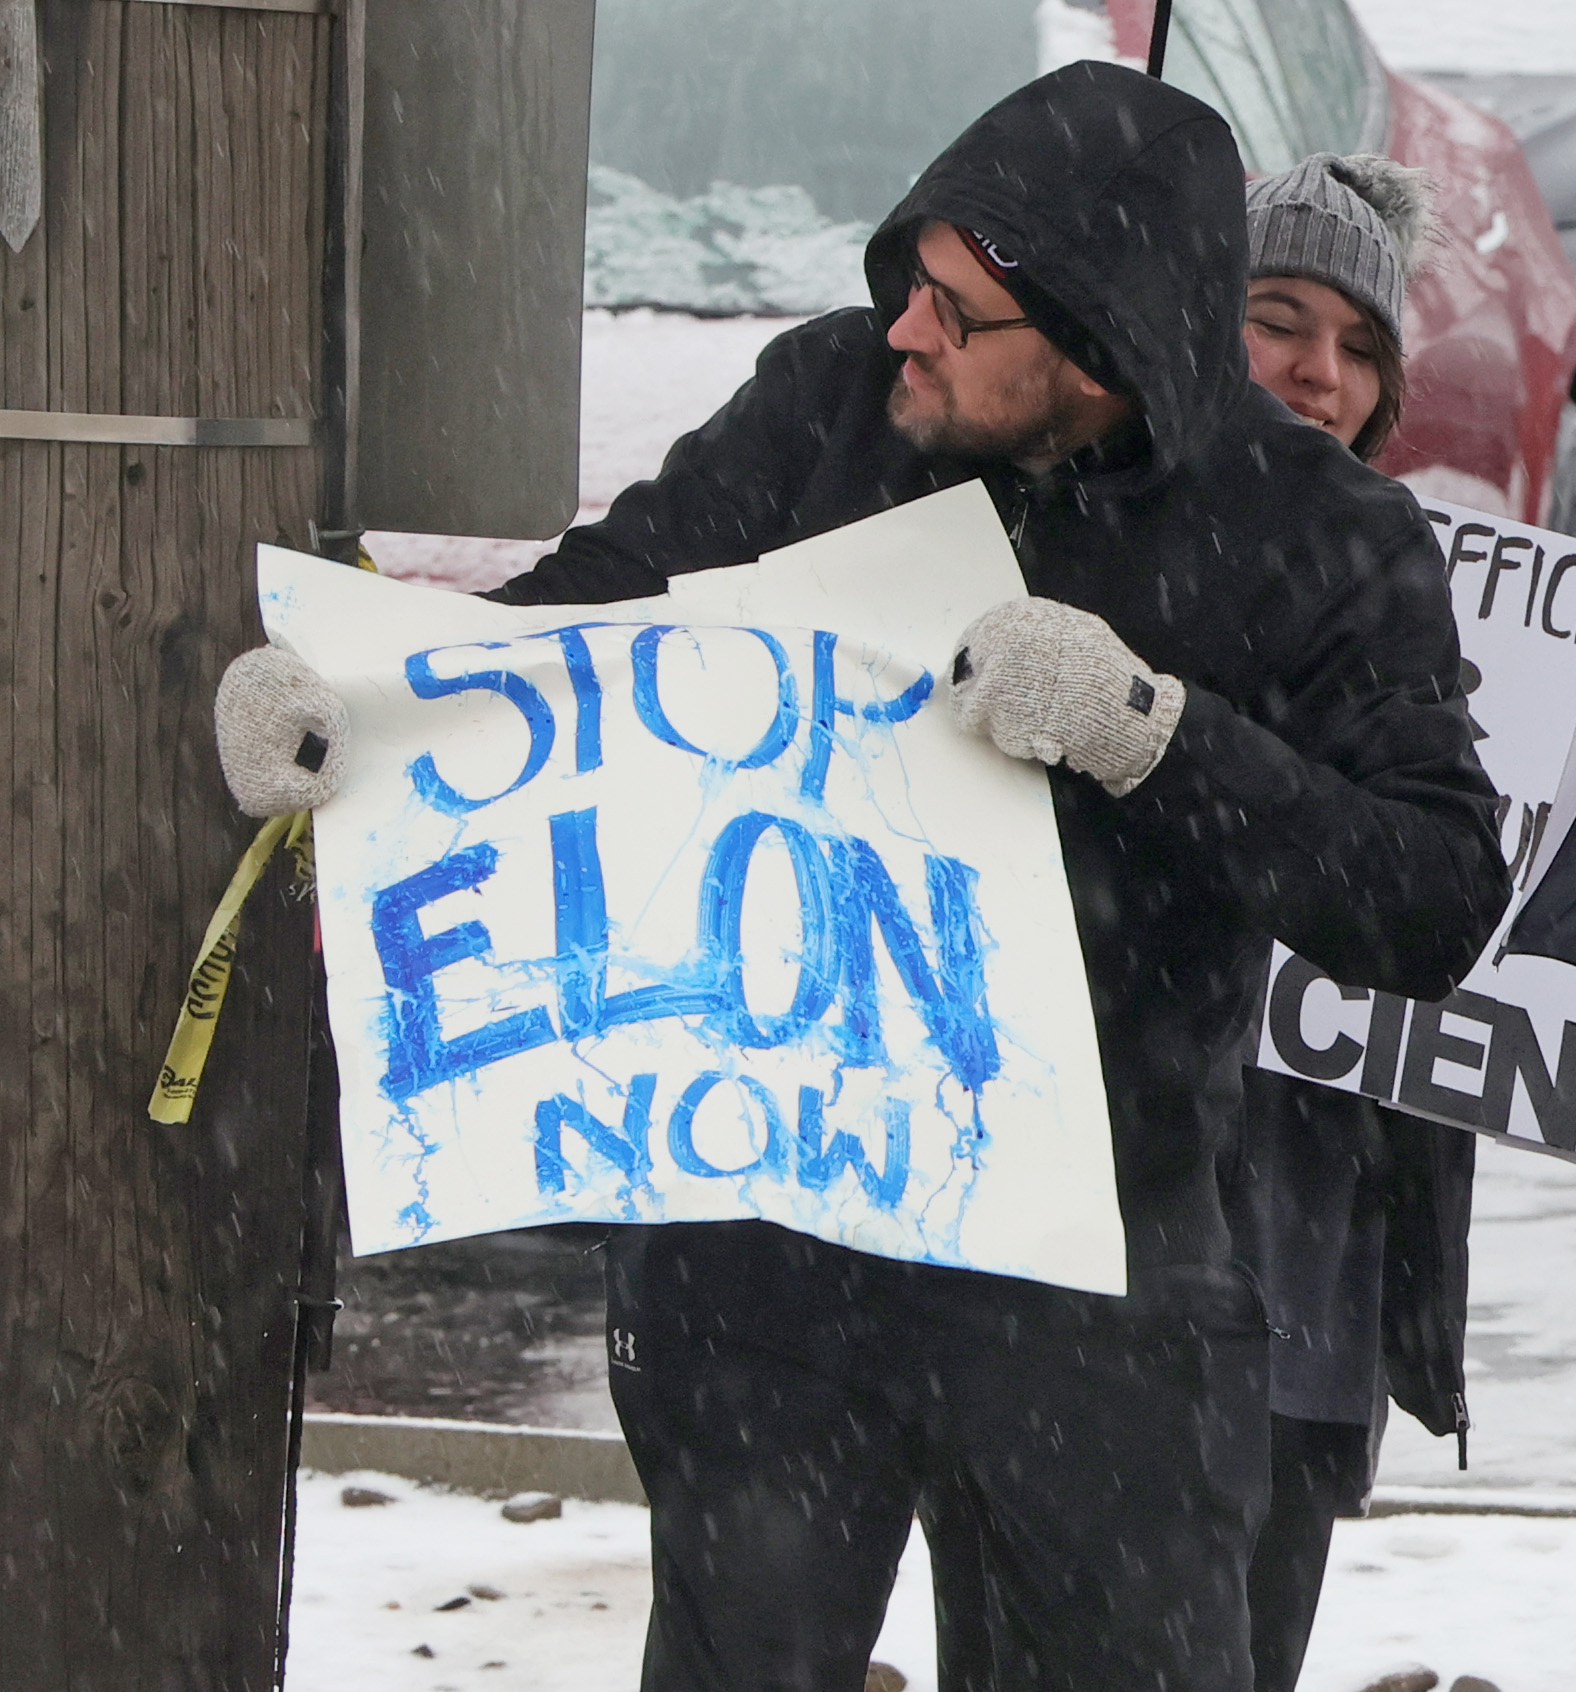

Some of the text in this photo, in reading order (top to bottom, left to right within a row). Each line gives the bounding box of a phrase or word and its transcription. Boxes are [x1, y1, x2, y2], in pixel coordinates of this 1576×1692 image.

[404, 621, 935, 812] STOP
[370, 806, 1002, 1104] ELON
[533, 1071, 912, 1210] NOW
